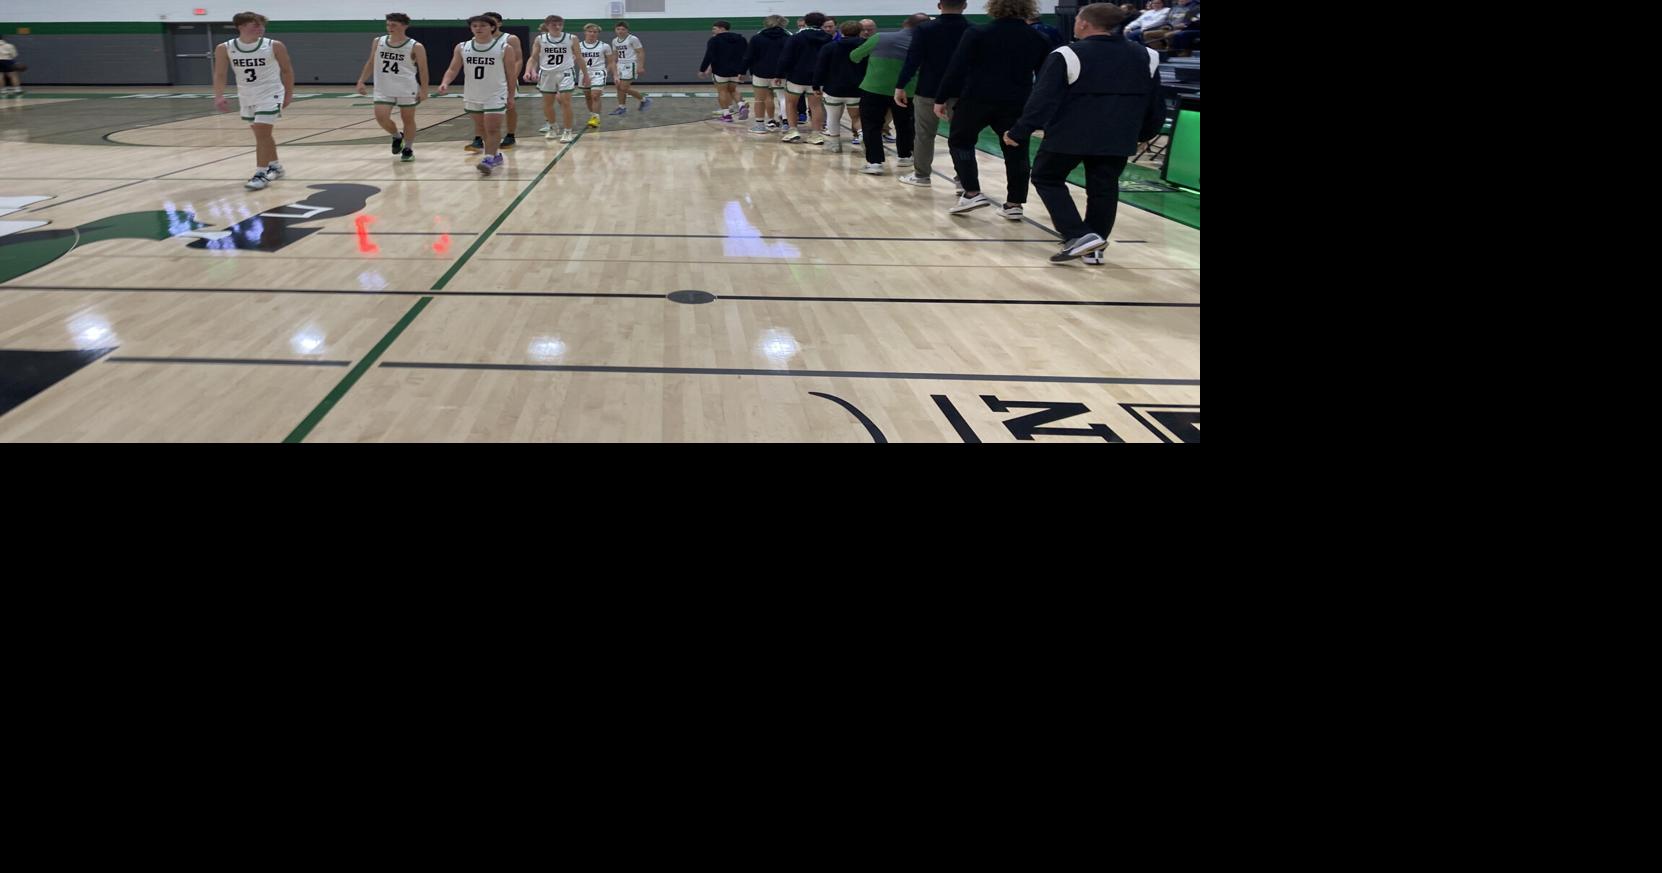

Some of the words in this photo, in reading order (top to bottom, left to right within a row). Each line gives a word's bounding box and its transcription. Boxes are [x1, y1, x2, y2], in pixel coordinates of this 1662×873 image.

[233, 58, 266, 67] REGIS
[466, 56, 496, 65] REGIS
[547, 54, 564, 65] 20
[587, 58, 593, 67] 4
[382, 60, 400, 74] 24
[244, 68, 257, 82] 3
[474, 66, 485, 80] 0
